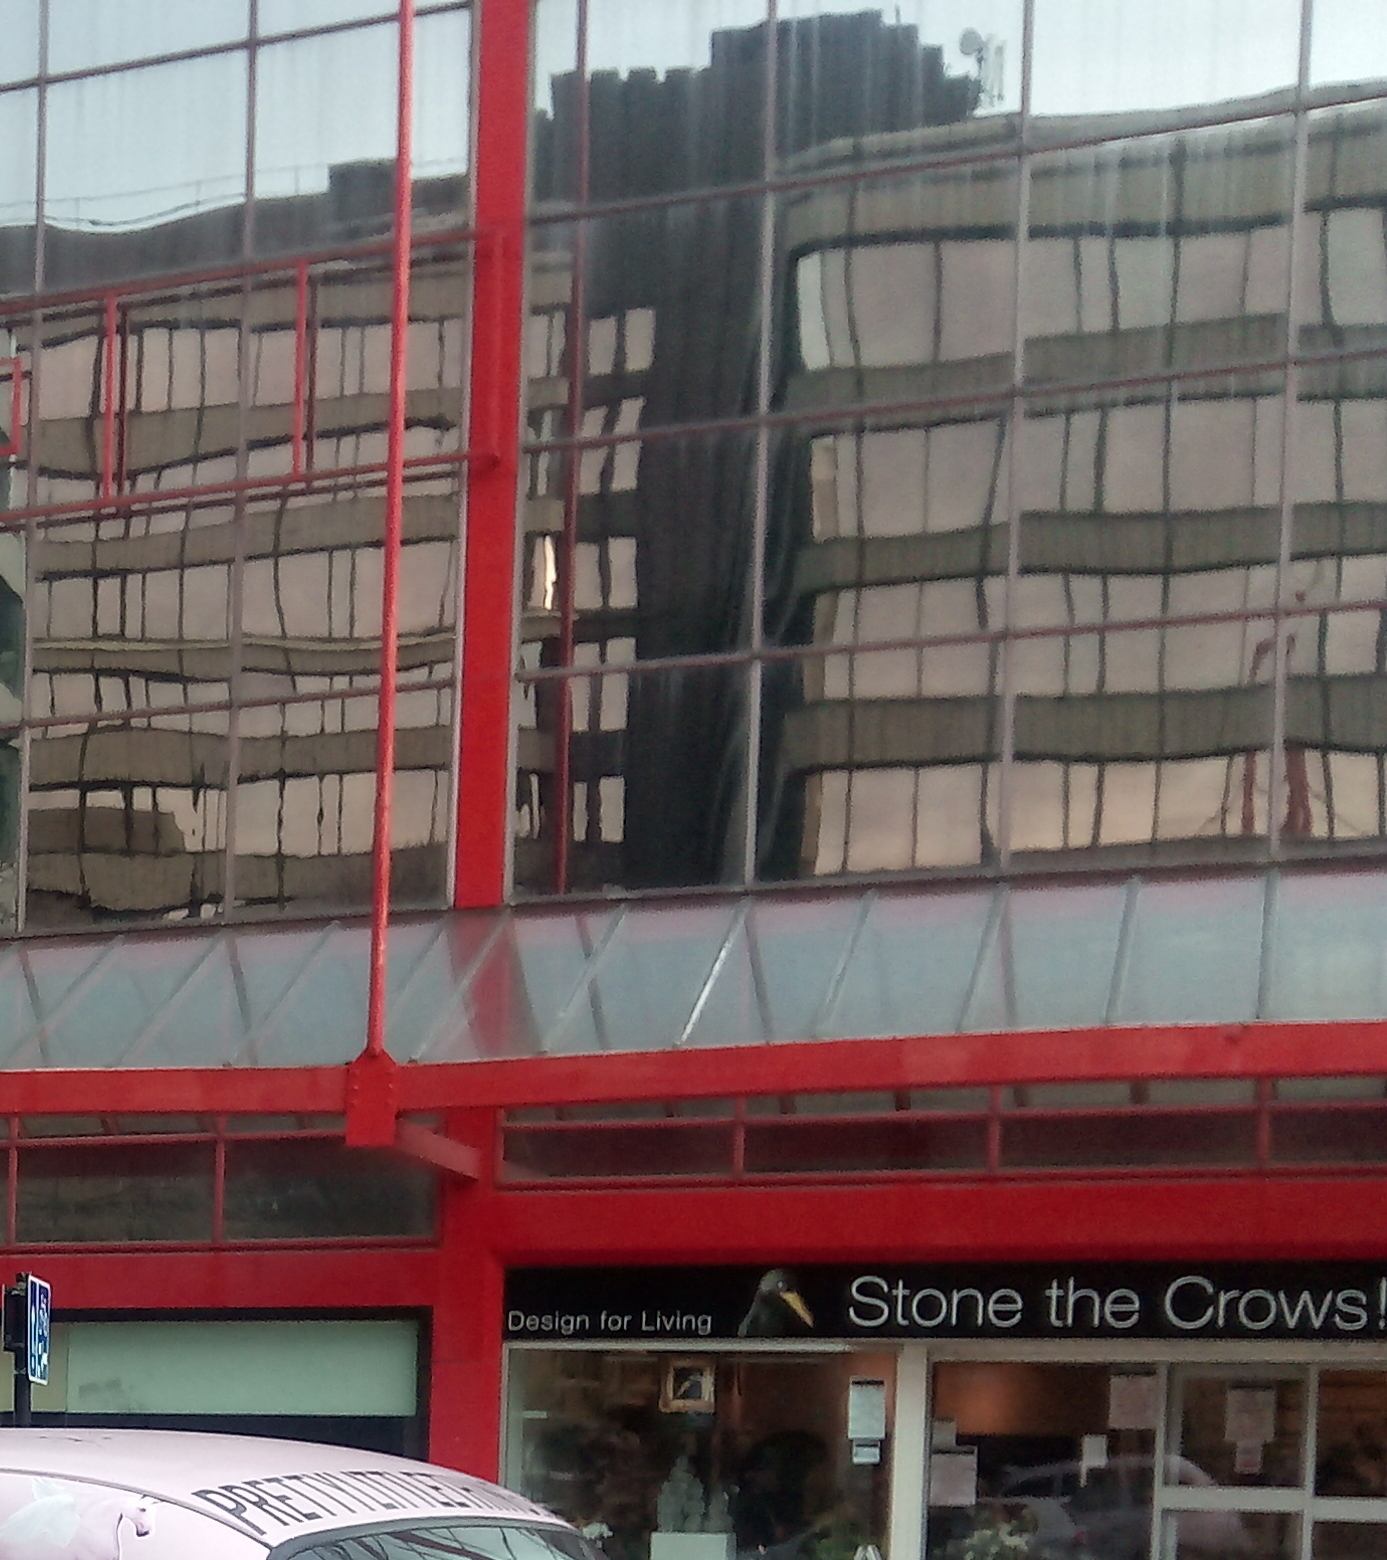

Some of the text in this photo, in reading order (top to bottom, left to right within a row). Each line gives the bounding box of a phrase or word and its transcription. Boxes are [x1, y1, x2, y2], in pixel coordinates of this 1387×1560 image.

[508, 1310, 712, 1335] Design for Living
[848, 1274, 1387, 1332] Stone the Crows!
